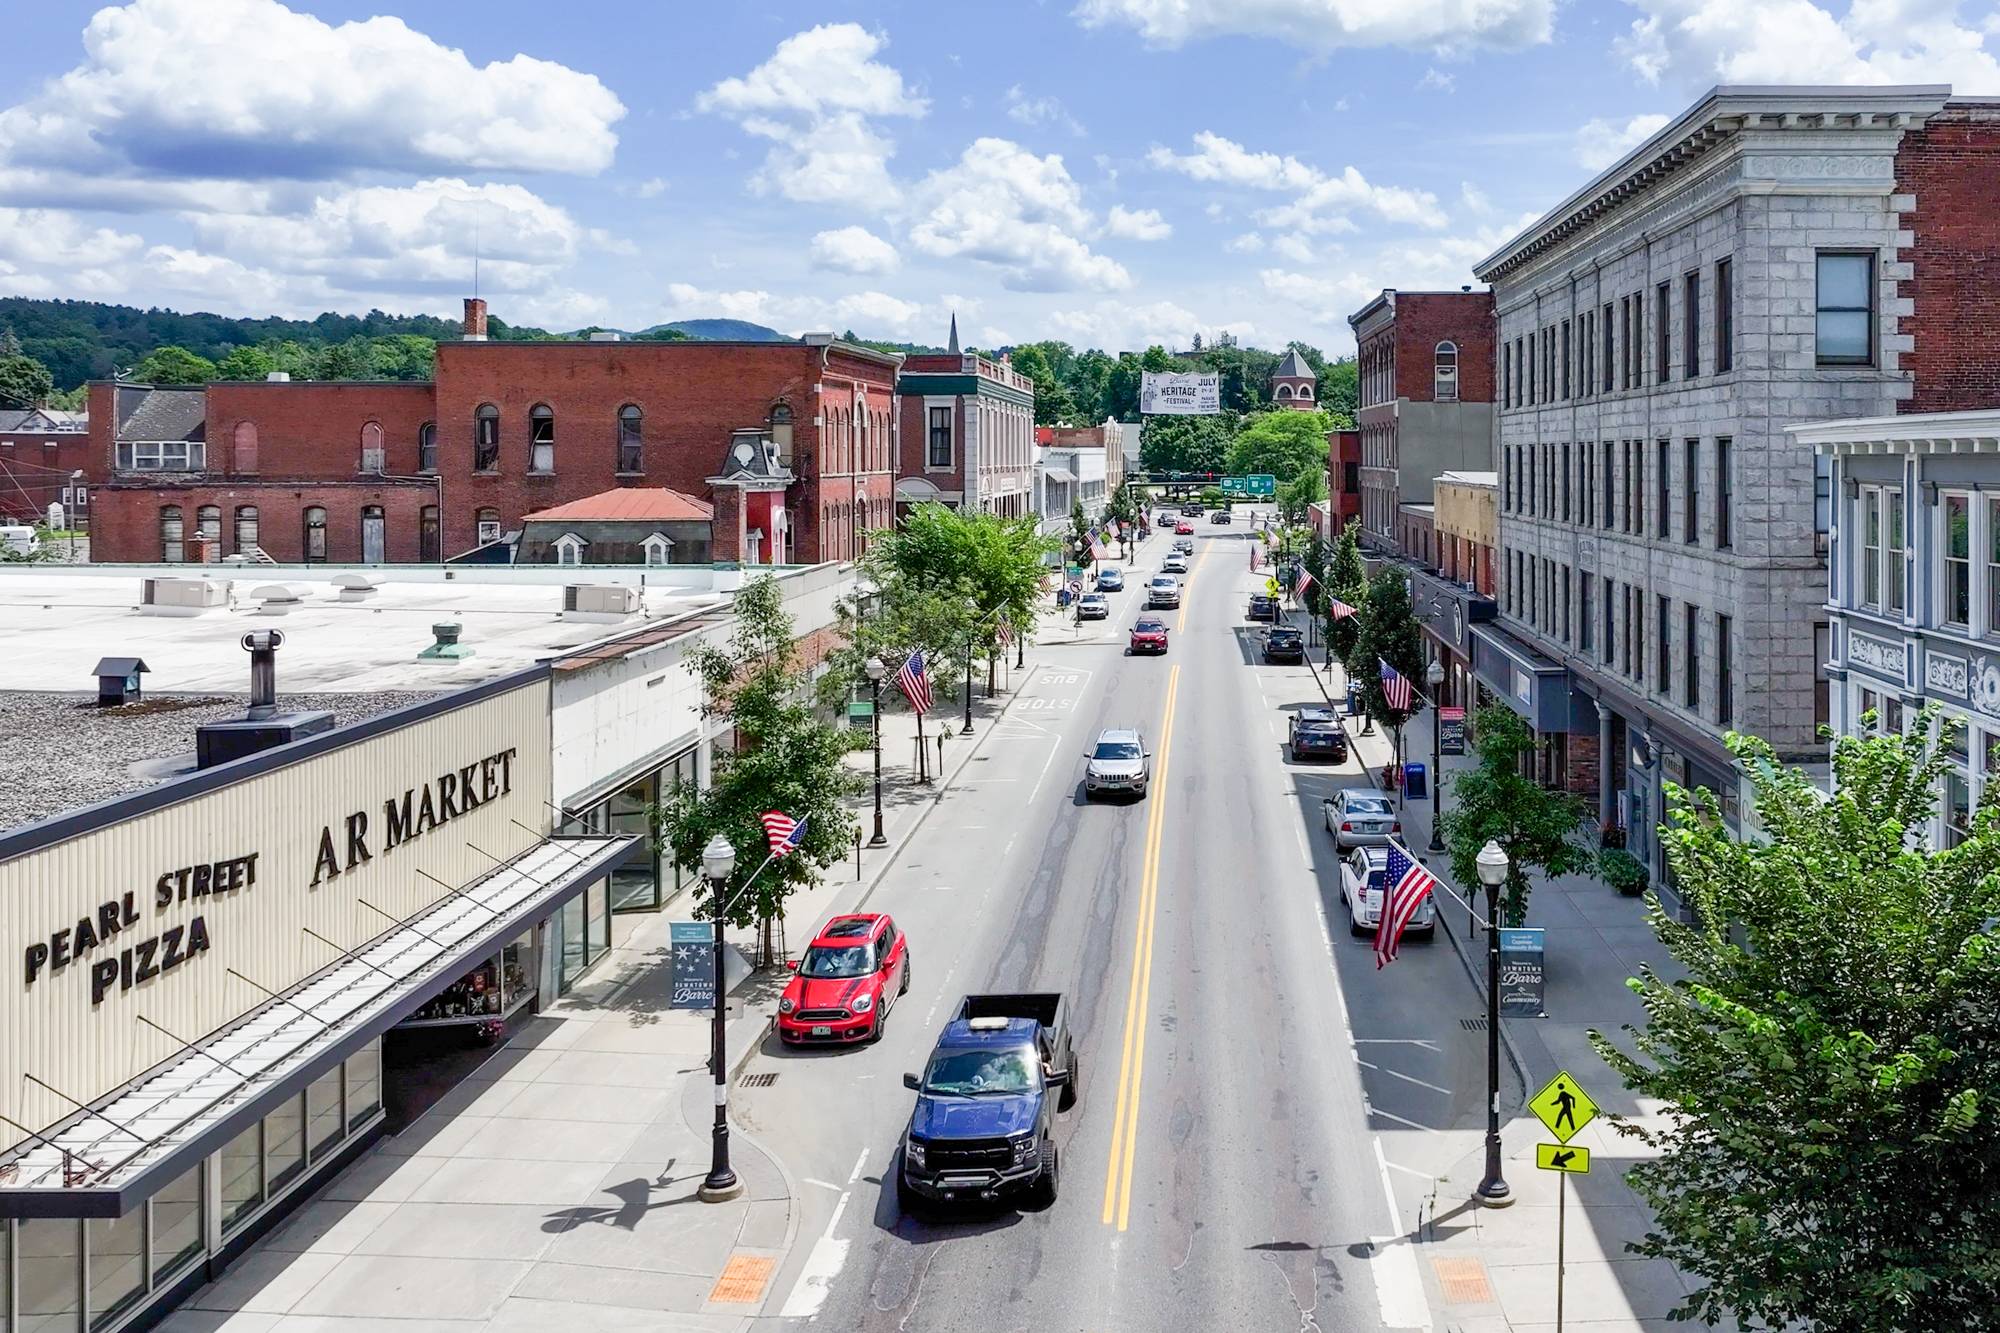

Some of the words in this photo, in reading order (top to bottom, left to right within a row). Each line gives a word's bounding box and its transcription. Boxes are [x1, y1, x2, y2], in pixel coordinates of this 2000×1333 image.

[1198, 378, 1217, 386] JULY
[1161, 387, 1196, 396] HERITAGE
[1040, 675, 1079, 684] BUS
[1017, 698, 1072, 709] STOP
[309, 811, 373, 887] AR
[383, 747, 516, 852] MARKET
[25, 890, 140, 984] PEARL
[156, 852, 259, 908] STREET
[91, 915, 210, 1005] PIZZA
[1502, 972, 1542, 986] Barre
[672, 988, 712, 1003] Barre
[1502, 996, 1540, 1005] Community
